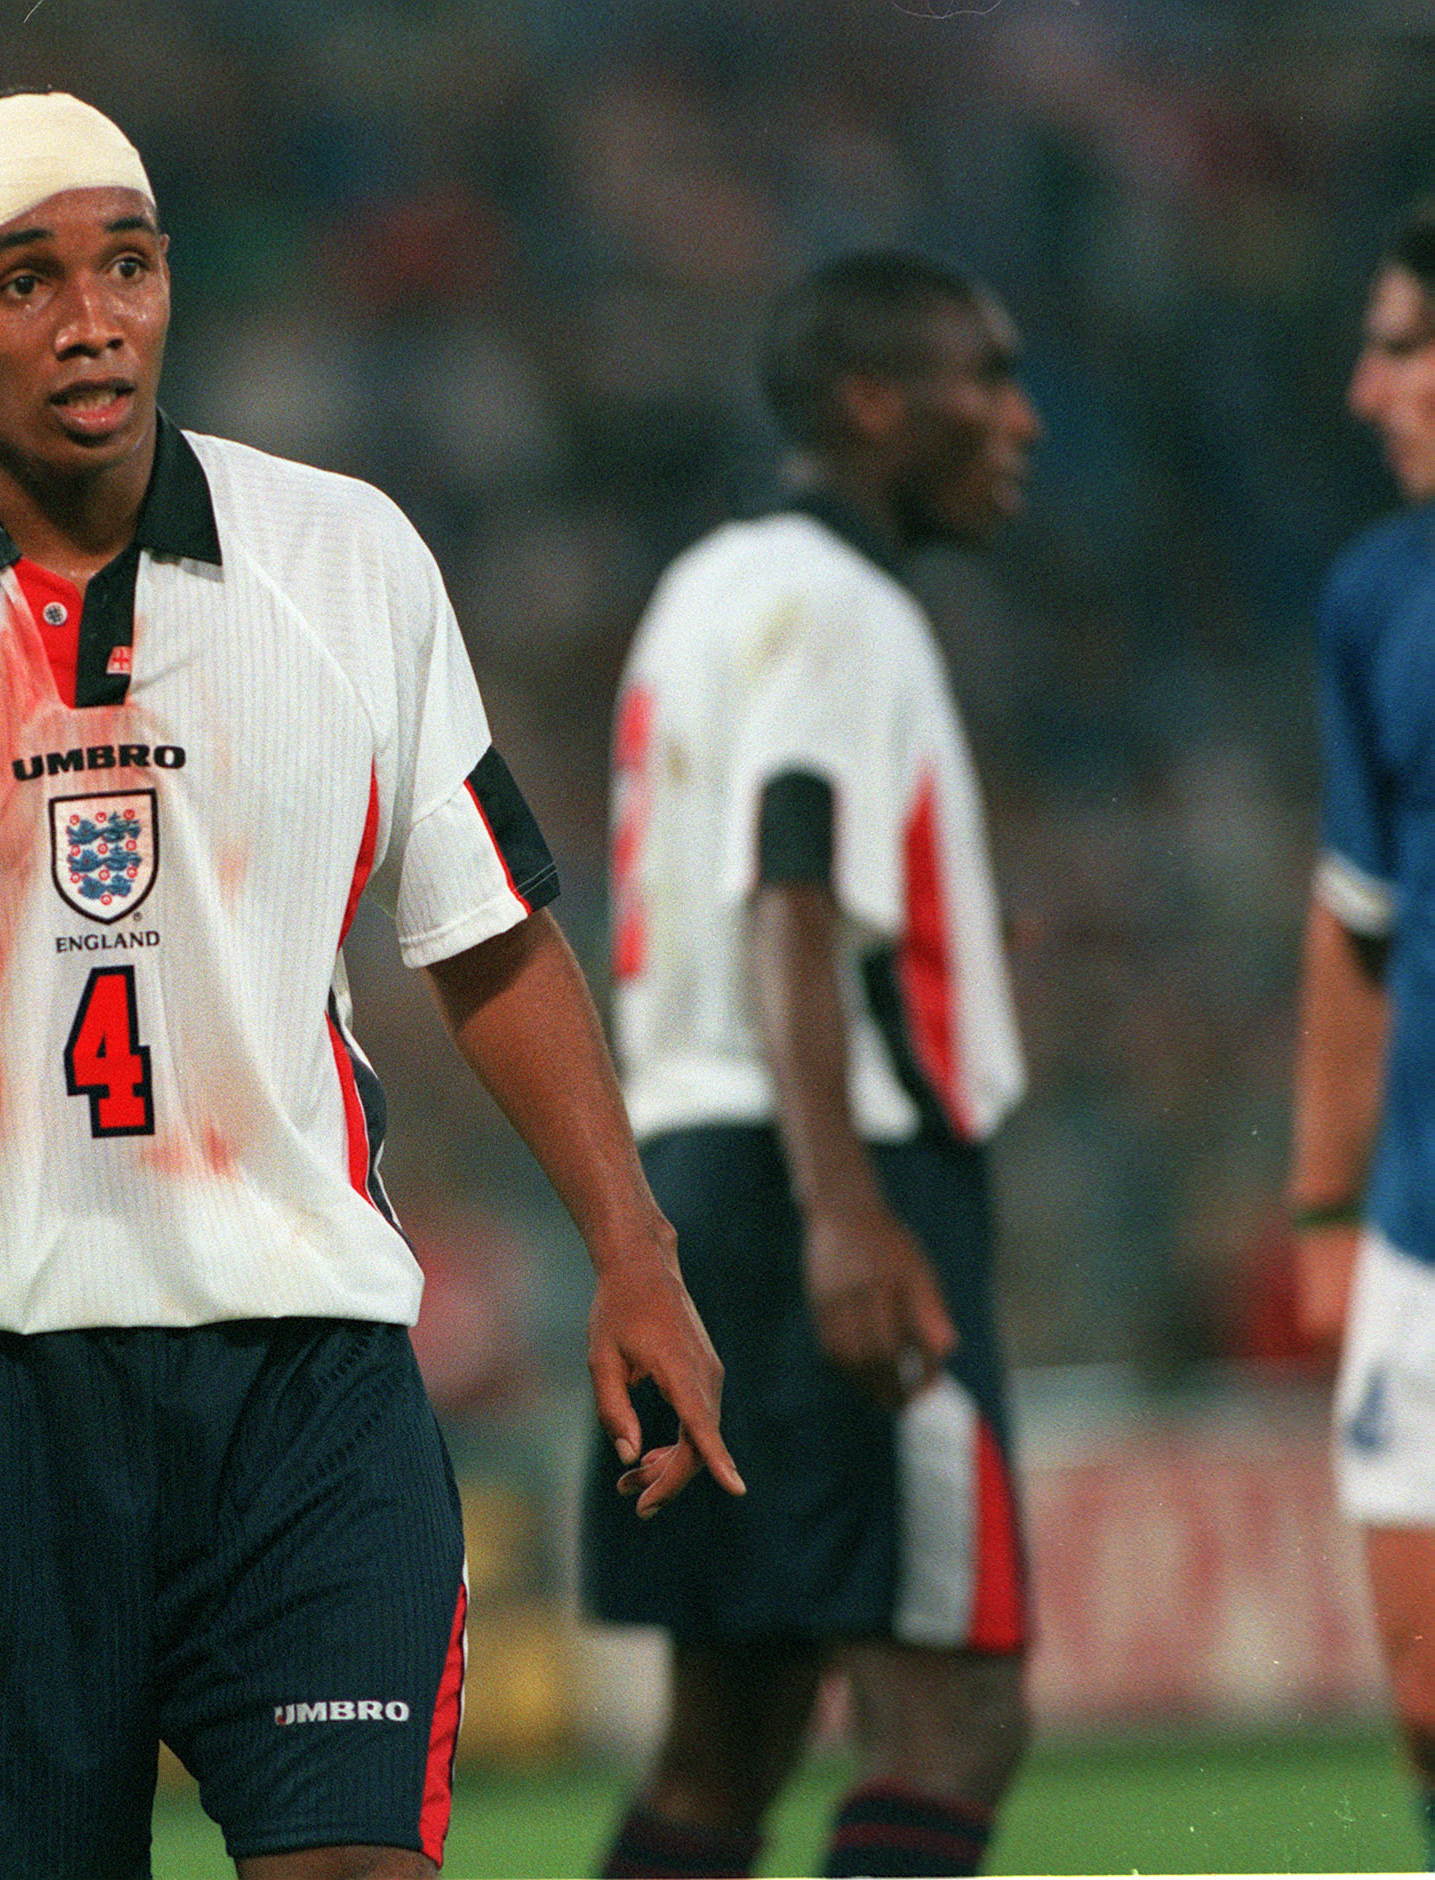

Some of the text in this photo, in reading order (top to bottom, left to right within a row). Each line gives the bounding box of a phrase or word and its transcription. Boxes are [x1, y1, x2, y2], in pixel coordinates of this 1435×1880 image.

[12, 744, 186, 782] UMBRO
[55, 930, 160, 953] ENGLAND
[64, 965, 155, 1138] 4
[274, 1700, 410, 1726] UMBRO
